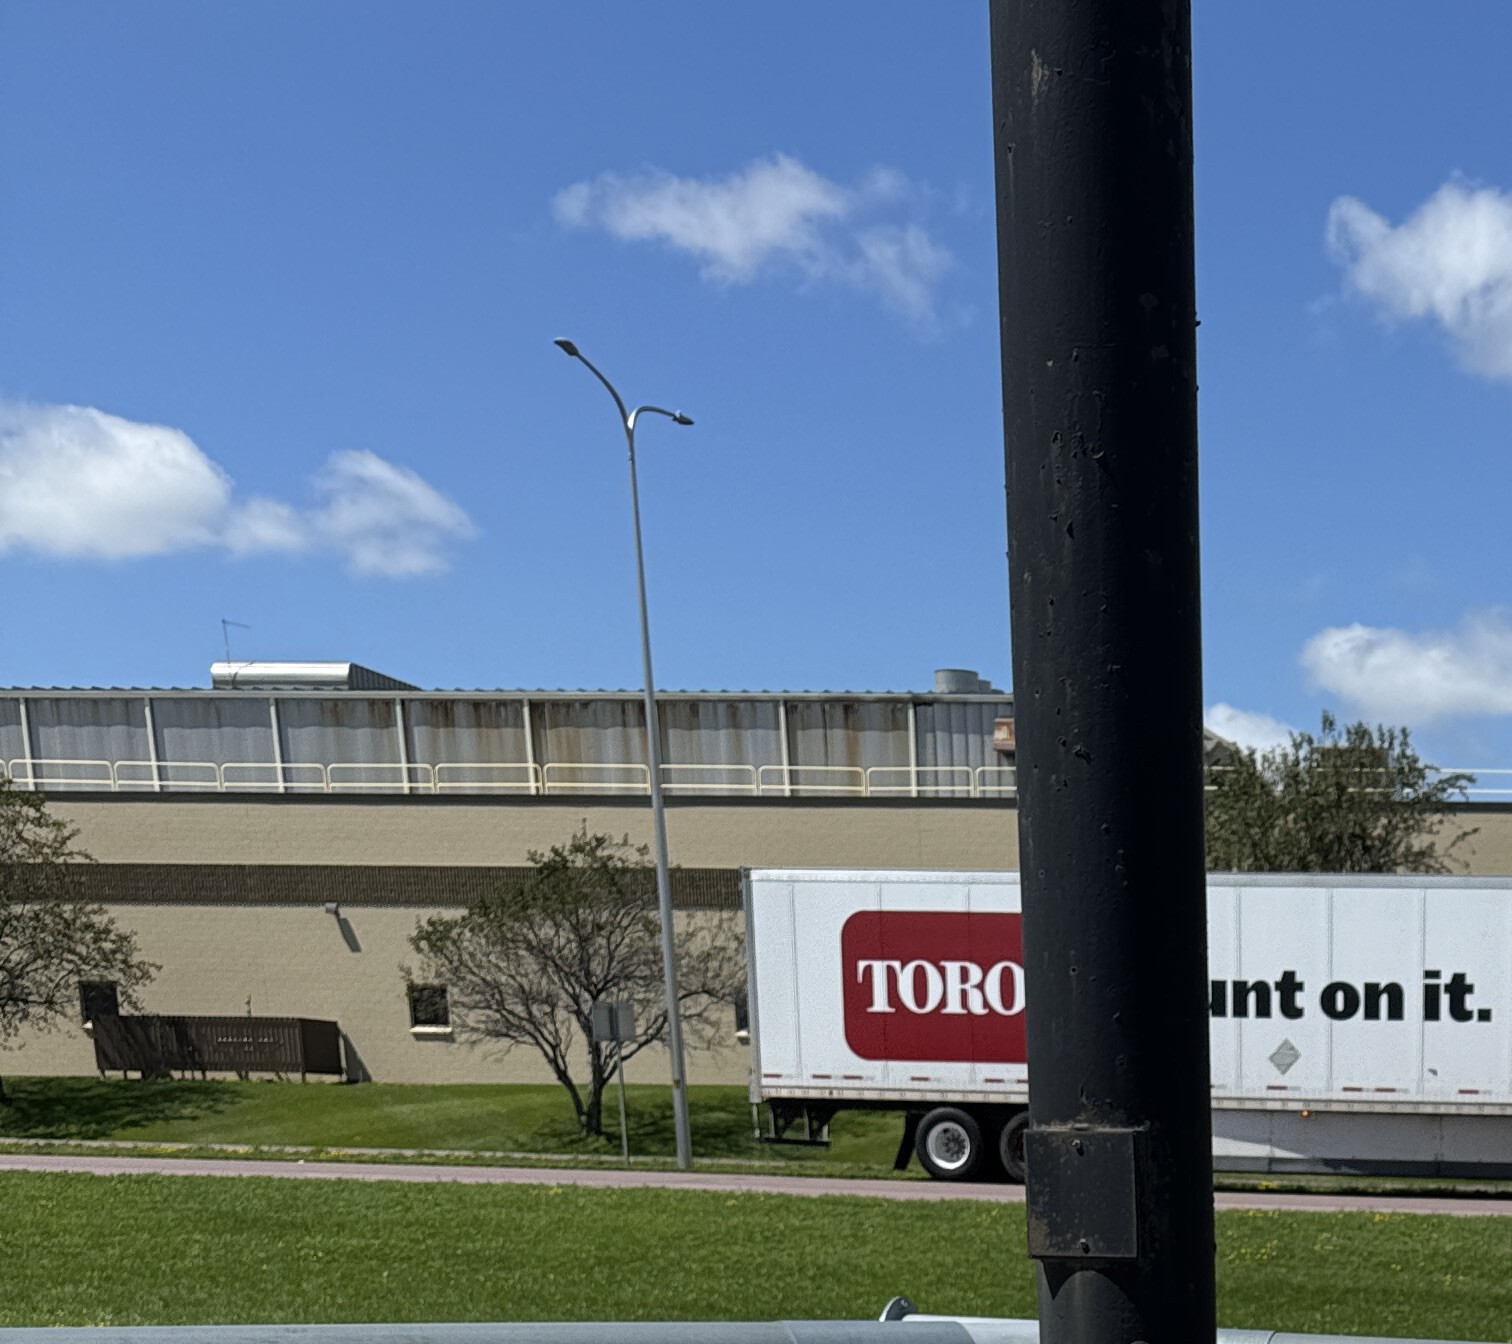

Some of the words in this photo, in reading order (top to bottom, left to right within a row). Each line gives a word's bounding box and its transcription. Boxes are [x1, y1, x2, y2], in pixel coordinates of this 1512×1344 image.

[856, 959, 1026, 1017] TORO
[1319, 980, 1405, 1022] on
[1423, 969, 1493, 1023] it.
